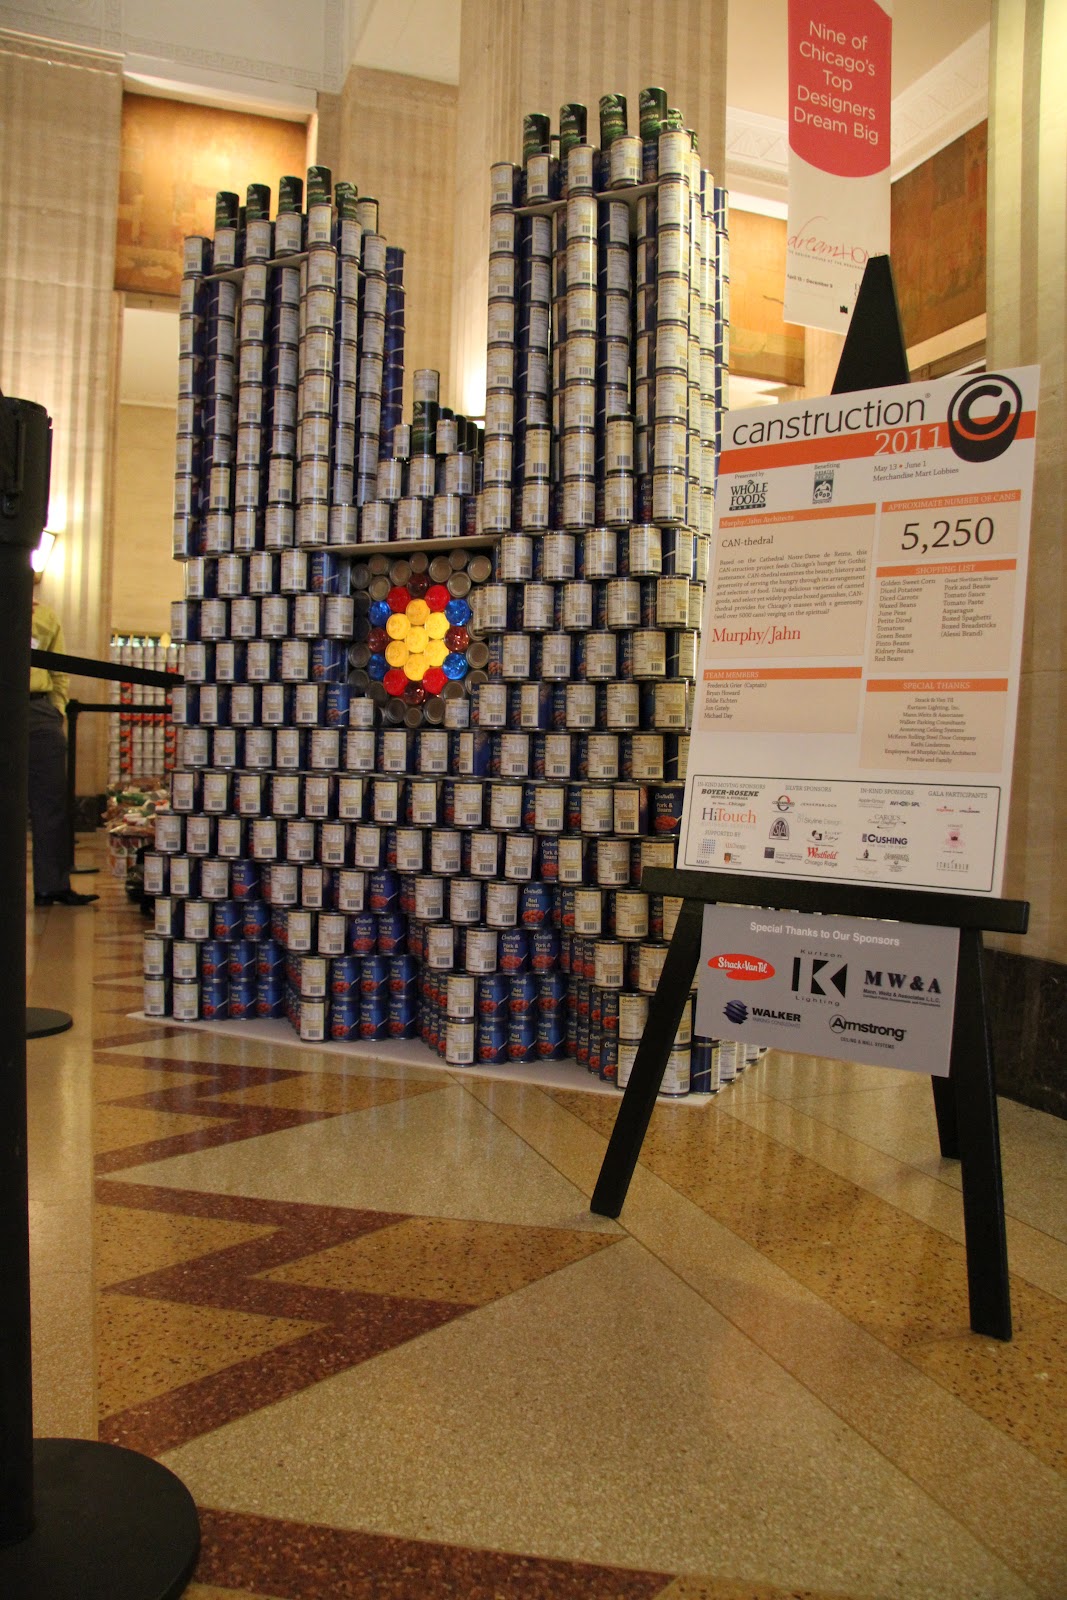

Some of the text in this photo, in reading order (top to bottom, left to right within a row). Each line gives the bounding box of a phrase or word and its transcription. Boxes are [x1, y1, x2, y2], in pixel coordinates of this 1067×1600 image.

[810, 21, 867, 51] Nine of
[800, 41, 875, 76] Chicago's
[823, 69, 853, 92] Top
[798, 85, 876, 120] Designers
[794, 106, 878, 145] Dream Big
[733, 398, 925, 446] canstruction
[874, 426, 944, 457] 2011
[873, 472, 913, 482] Merchandise
[933, 467, 959, 476] Lobbies
[874, 465, 887, 473] May
[905, 462, 921, 470] June
[731, 481, 768, 495] WHOLE
[731, 493, 766, 506] FOODS
[888, 500, 943, 511] APPROXIMATE
[945, 497, 979, 505] NUMBER
[994, 493, 1016, 501] CANS
[721, 518, 762, 528] Murphy/Jahn
[722, 536, 774, 548] CAN-thedral
[901, 517, 994, 554] 5,250
[916, 564, 976, 575] SHOPPING LIST
[712, 626, 801, 645] Murphy/Jahn
[701, 789, 759, 797] BOYER-ROSENE
[946, 791, 988, 799] PARTICIPANTS
[702, 807, 756, 824] HiTouch
[868, 834, 908, 845] CUSHING
[808, 847, 838, 860] Westfield
[750, 922, 901, 947] Special Thanks to Our Sponsors
[800, 949, 843, 959] Kurtzon
[795, 995, 841, 1007] Lighting
[898, 993, 925, 1001] Associates
[752, 1007, 801, 1022] WALKER
[831, 1015, 905, 1042] Armstrong
[840, 1036, 857, 1045] CEILING
[875, 1042, 895, 1050] SYSTEMS
